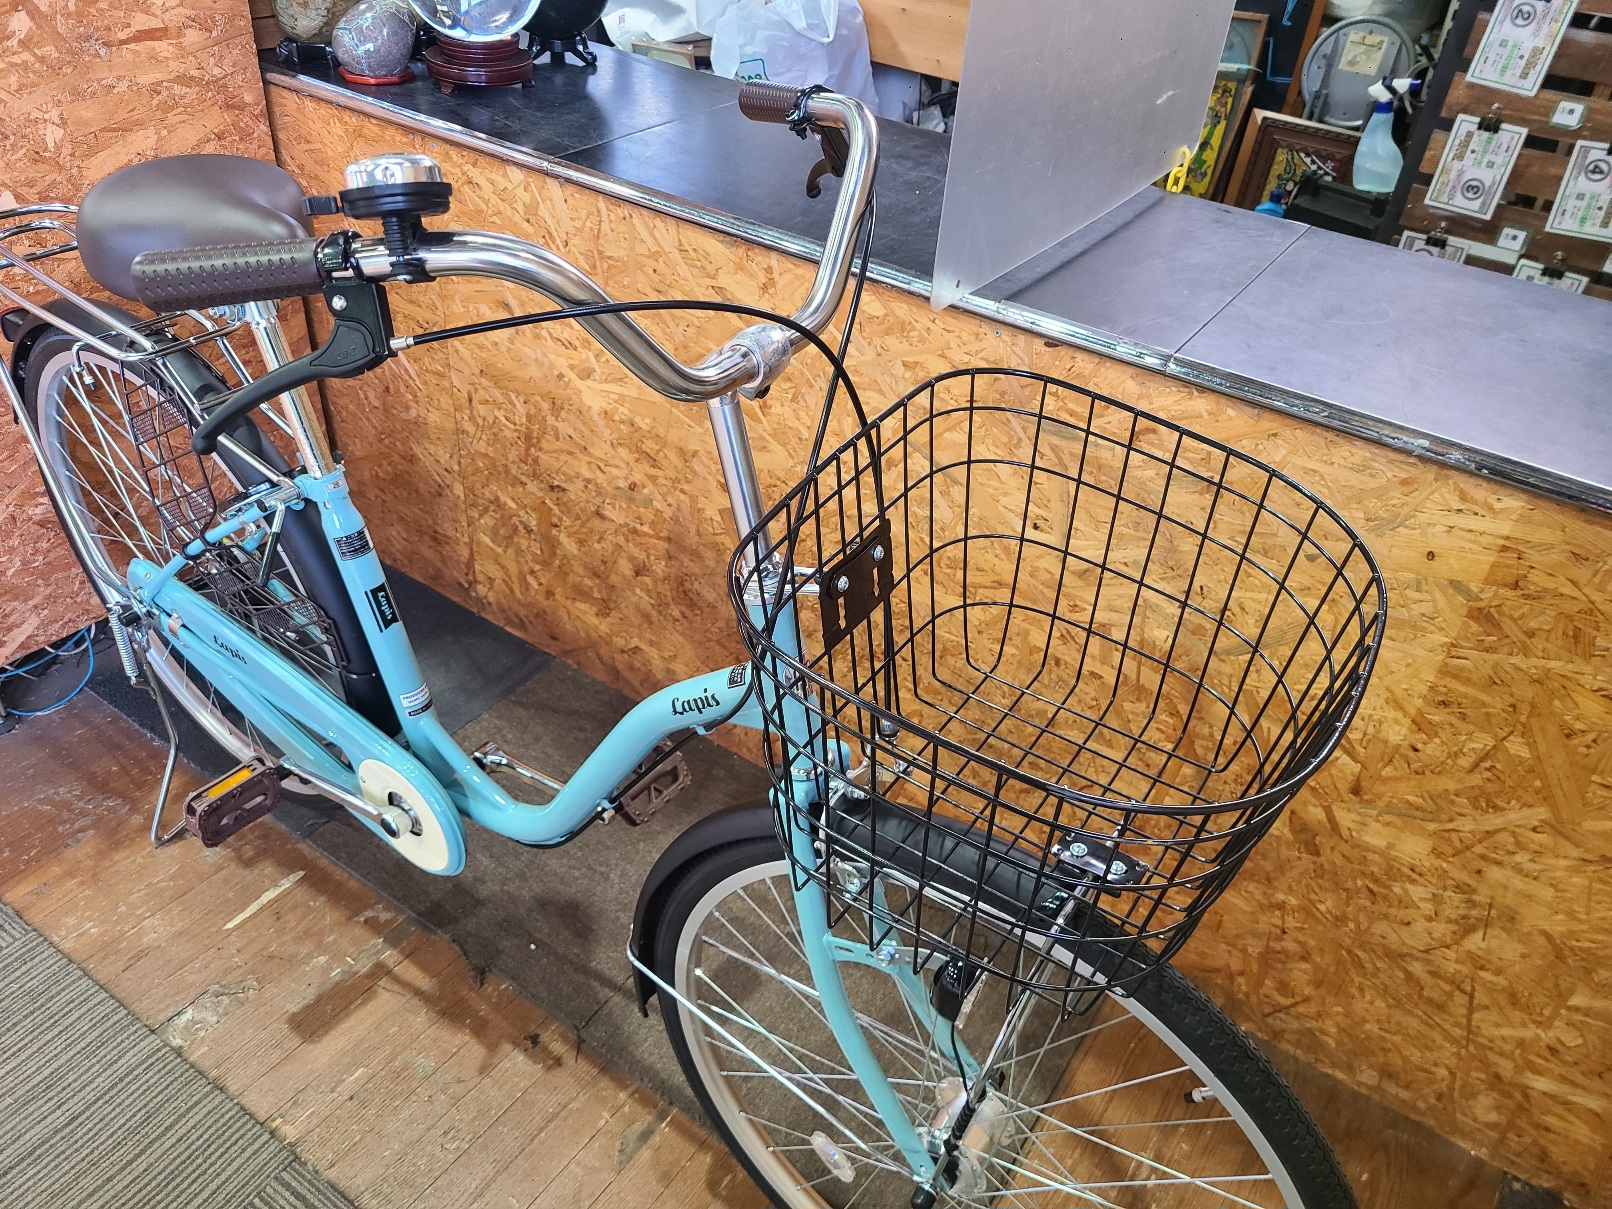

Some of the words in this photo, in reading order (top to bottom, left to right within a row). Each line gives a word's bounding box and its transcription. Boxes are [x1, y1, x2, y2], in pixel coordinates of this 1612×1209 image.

[377, 590, 393, 621] Lapis
[213, 635, 248, 665] Lapis
[671, 687, 721, 716] Lapis
